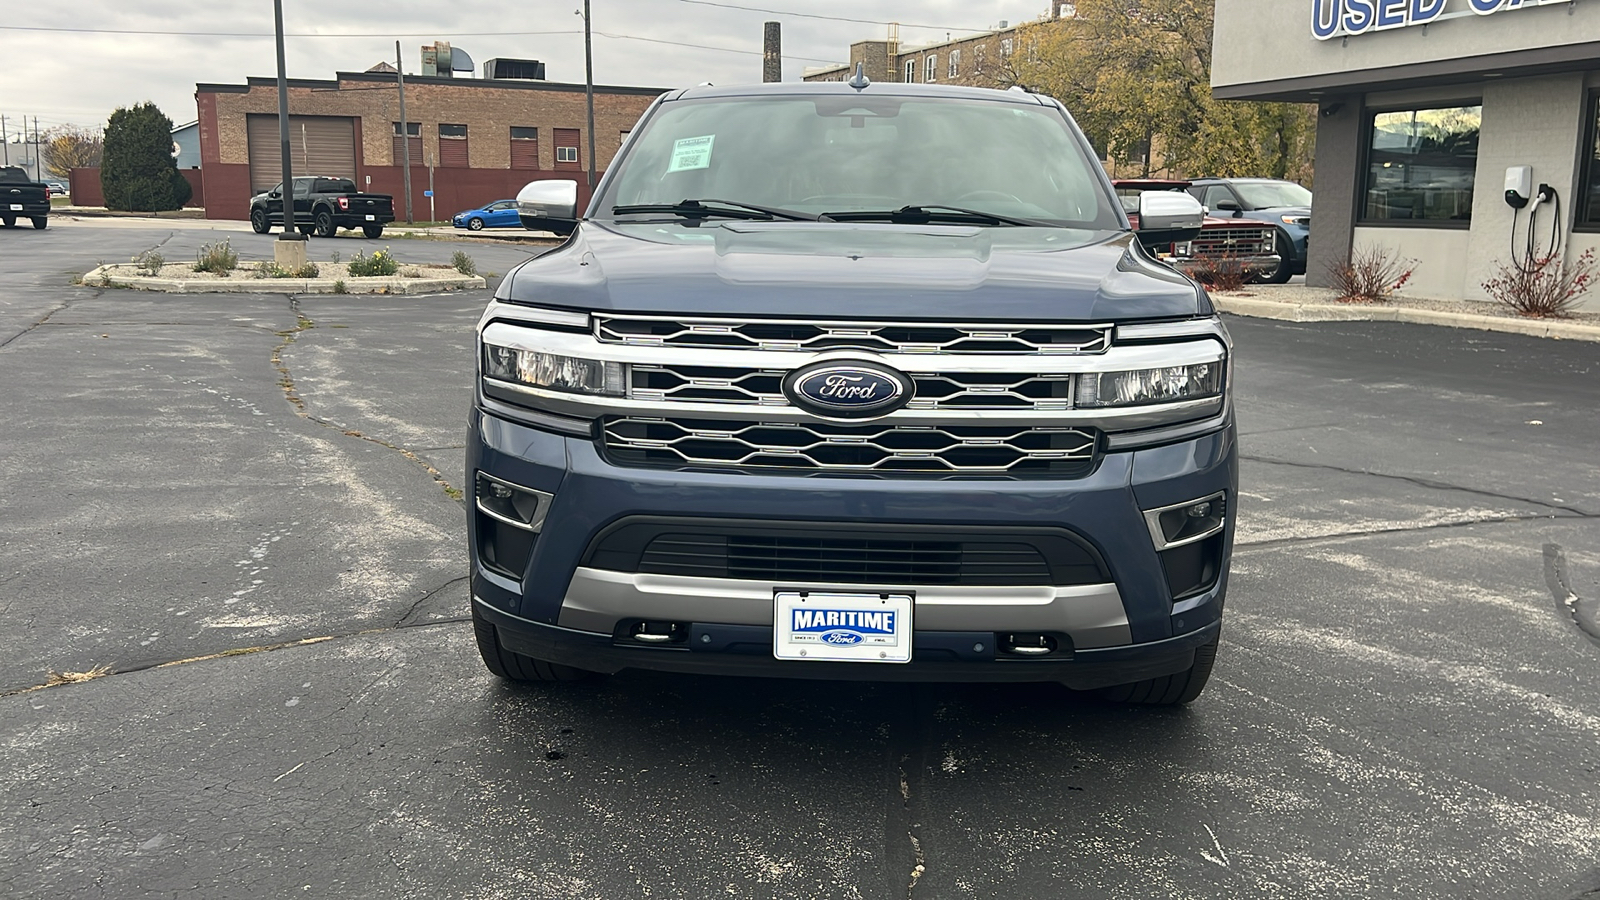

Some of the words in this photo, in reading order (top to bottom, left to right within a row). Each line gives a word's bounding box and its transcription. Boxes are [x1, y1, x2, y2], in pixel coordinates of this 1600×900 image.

[819, 375, 878, 399] Ford
[794, 610, 893, 633] MARITIME
[827, 632, 856, 644] Ford
